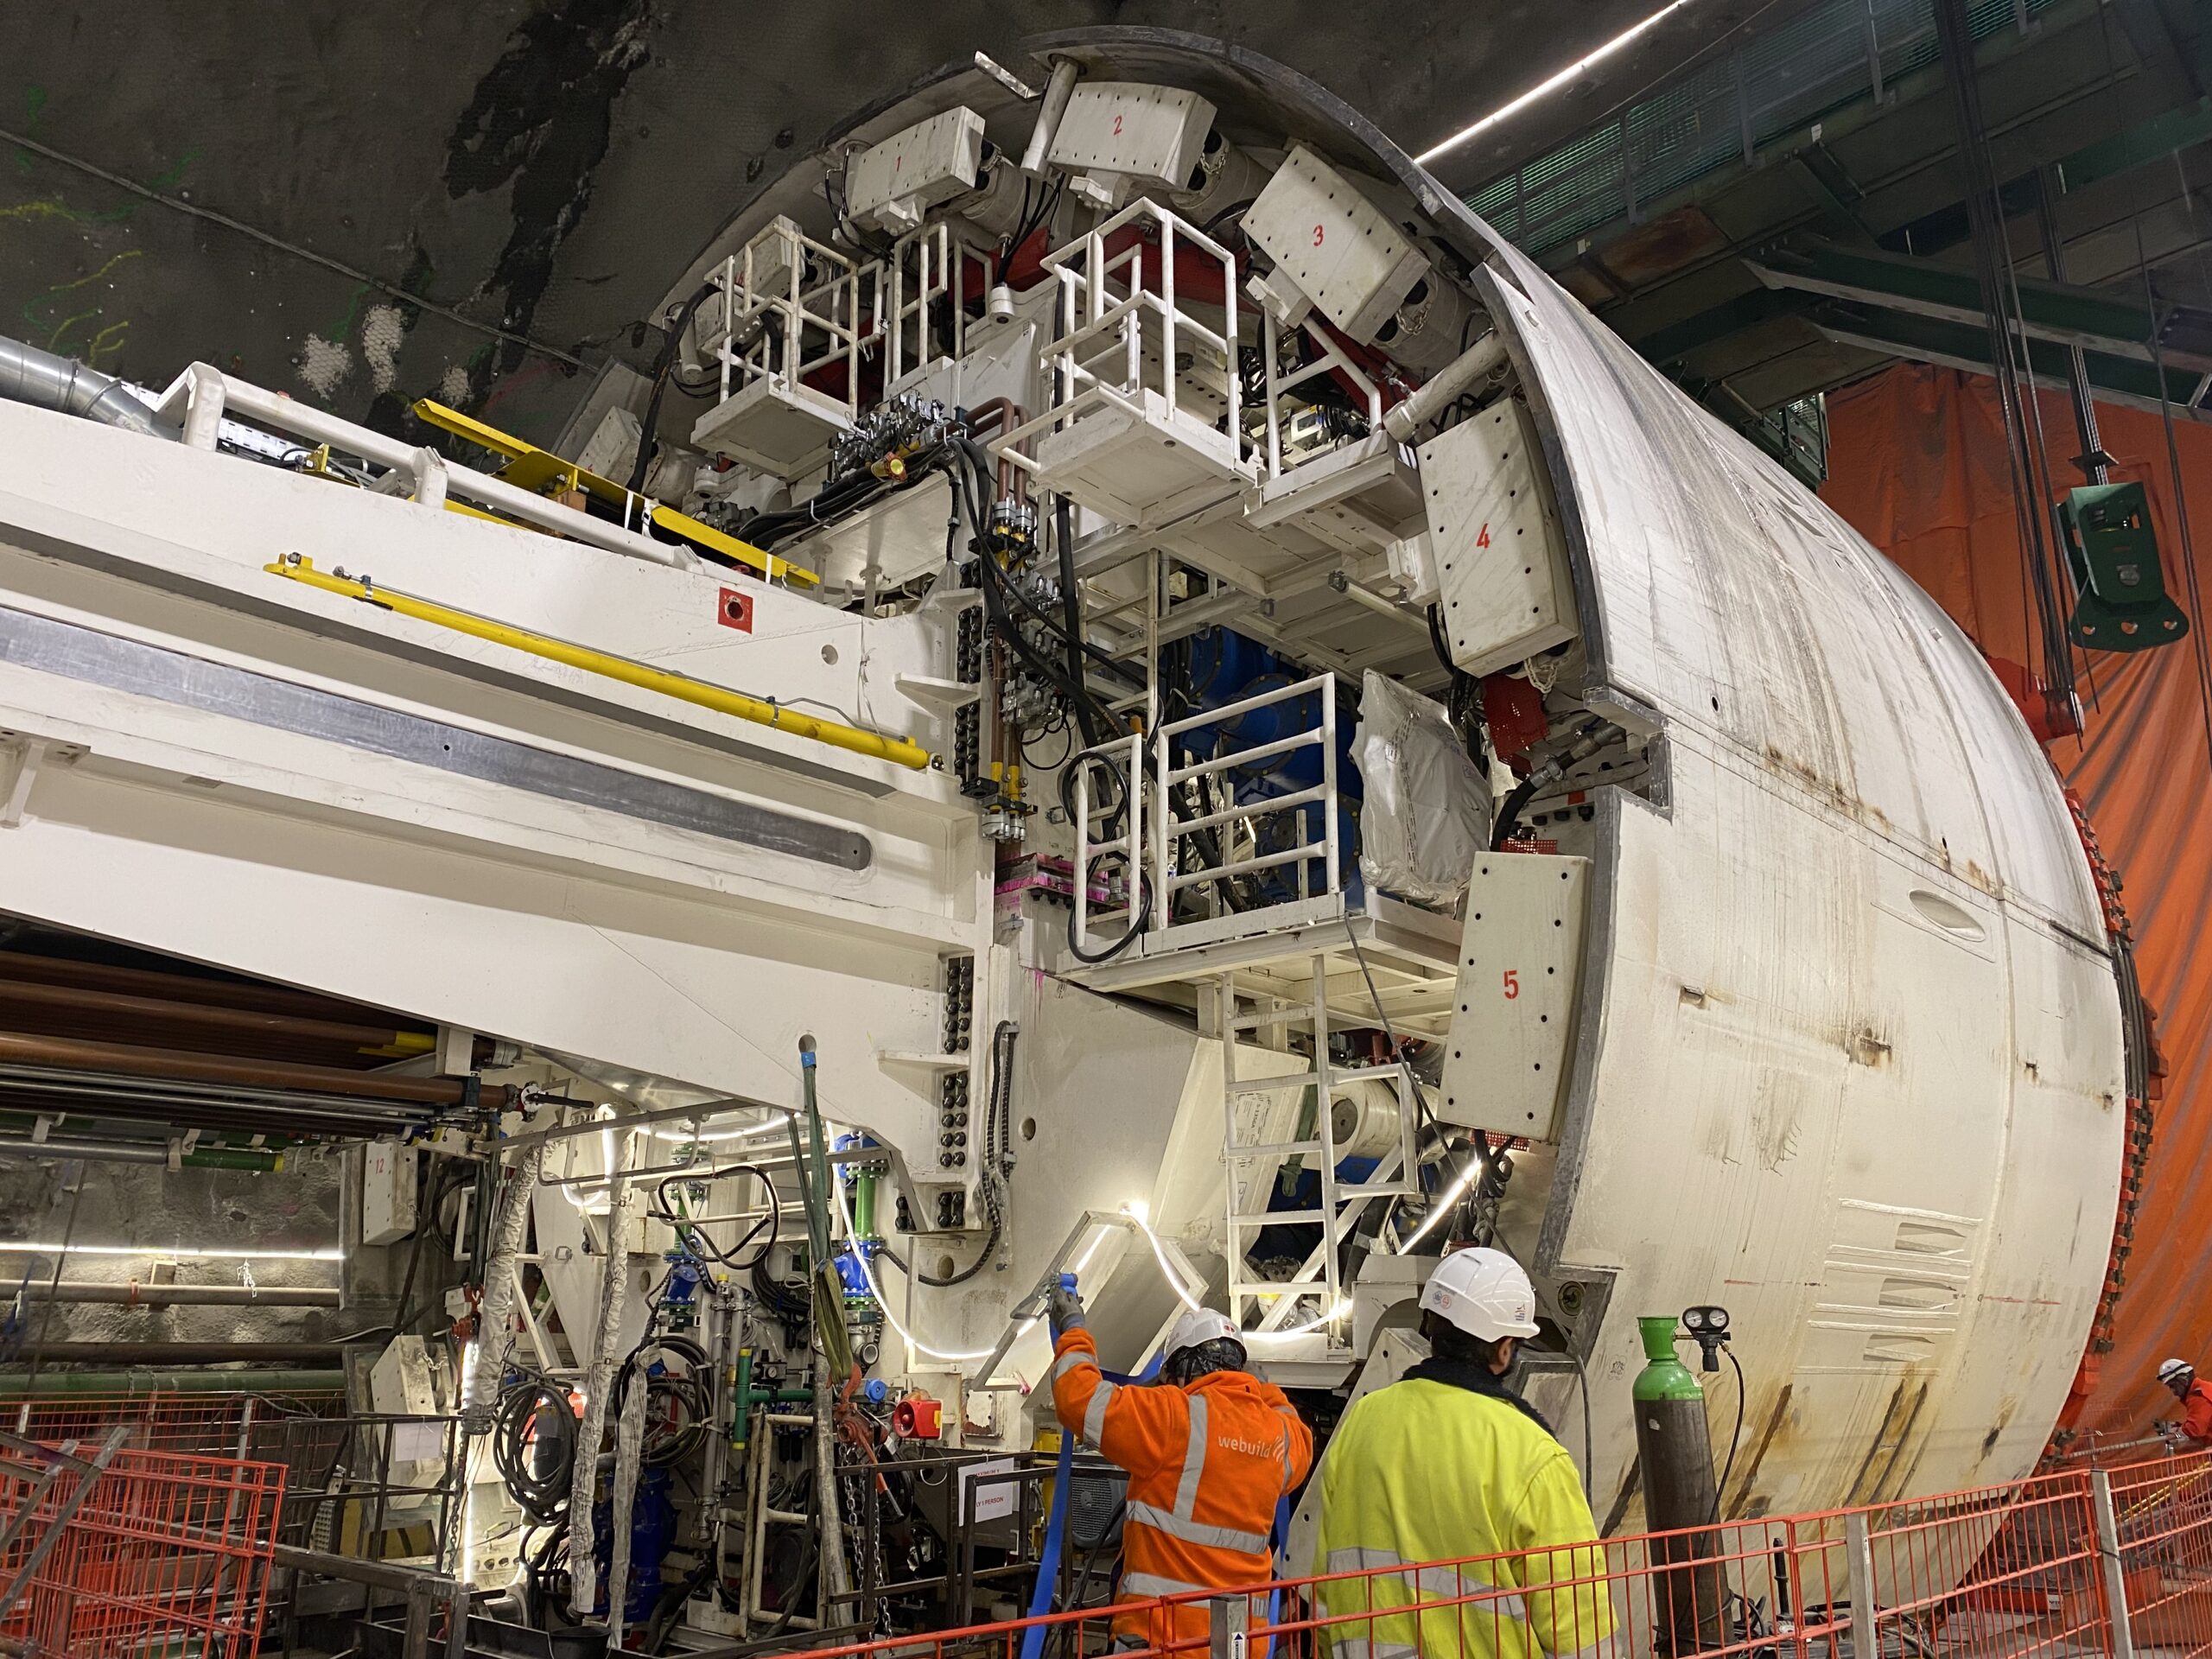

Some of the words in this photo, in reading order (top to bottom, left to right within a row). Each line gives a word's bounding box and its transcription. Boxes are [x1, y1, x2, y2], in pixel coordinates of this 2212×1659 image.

[1114, 115, 1122, 136] 2
[896, 156, 901, 172] 1
[1313, 225, 1324, 246] 3
[1477, 523, 1491, 549] 4
[1503, 969, 1519, 1000] 5
[376, 1158, 385, 1174] 12
[1218, 1436, 1272, 1458] webuild
[985, 1497, 1004, 1505] PERSON
